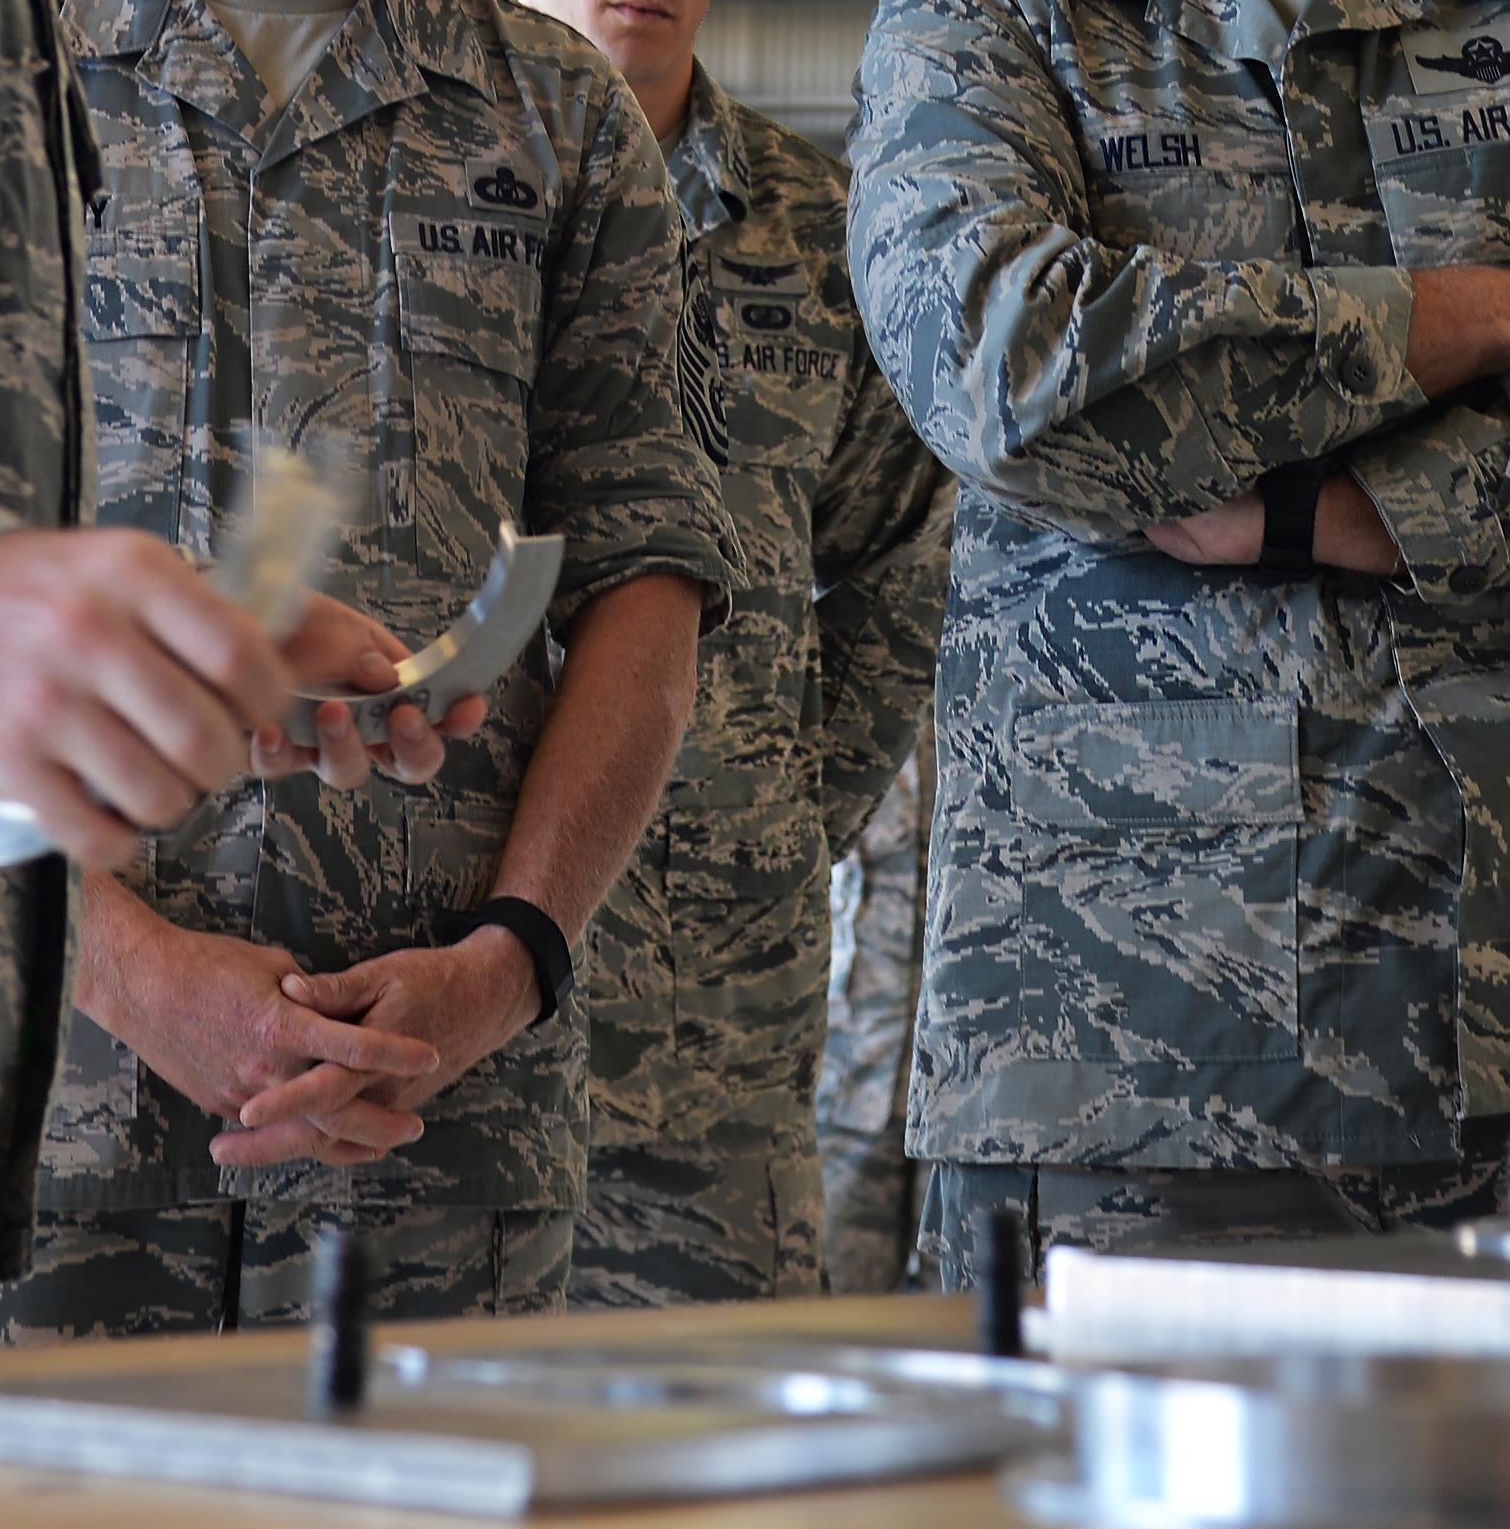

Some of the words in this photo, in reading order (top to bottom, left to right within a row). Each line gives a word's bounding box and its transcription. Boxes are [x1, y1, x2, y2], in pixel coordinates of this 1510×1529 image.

[1099, 134, 1203, 173] WELSH
[1391, 114, 1451, 155] U.S.
[417, 222, 464, 254] U.S.
[472, 225, 518, 262] AIR
[743, 344, 777, 372] AIR
[783, 346, 841, 380] FORCE
